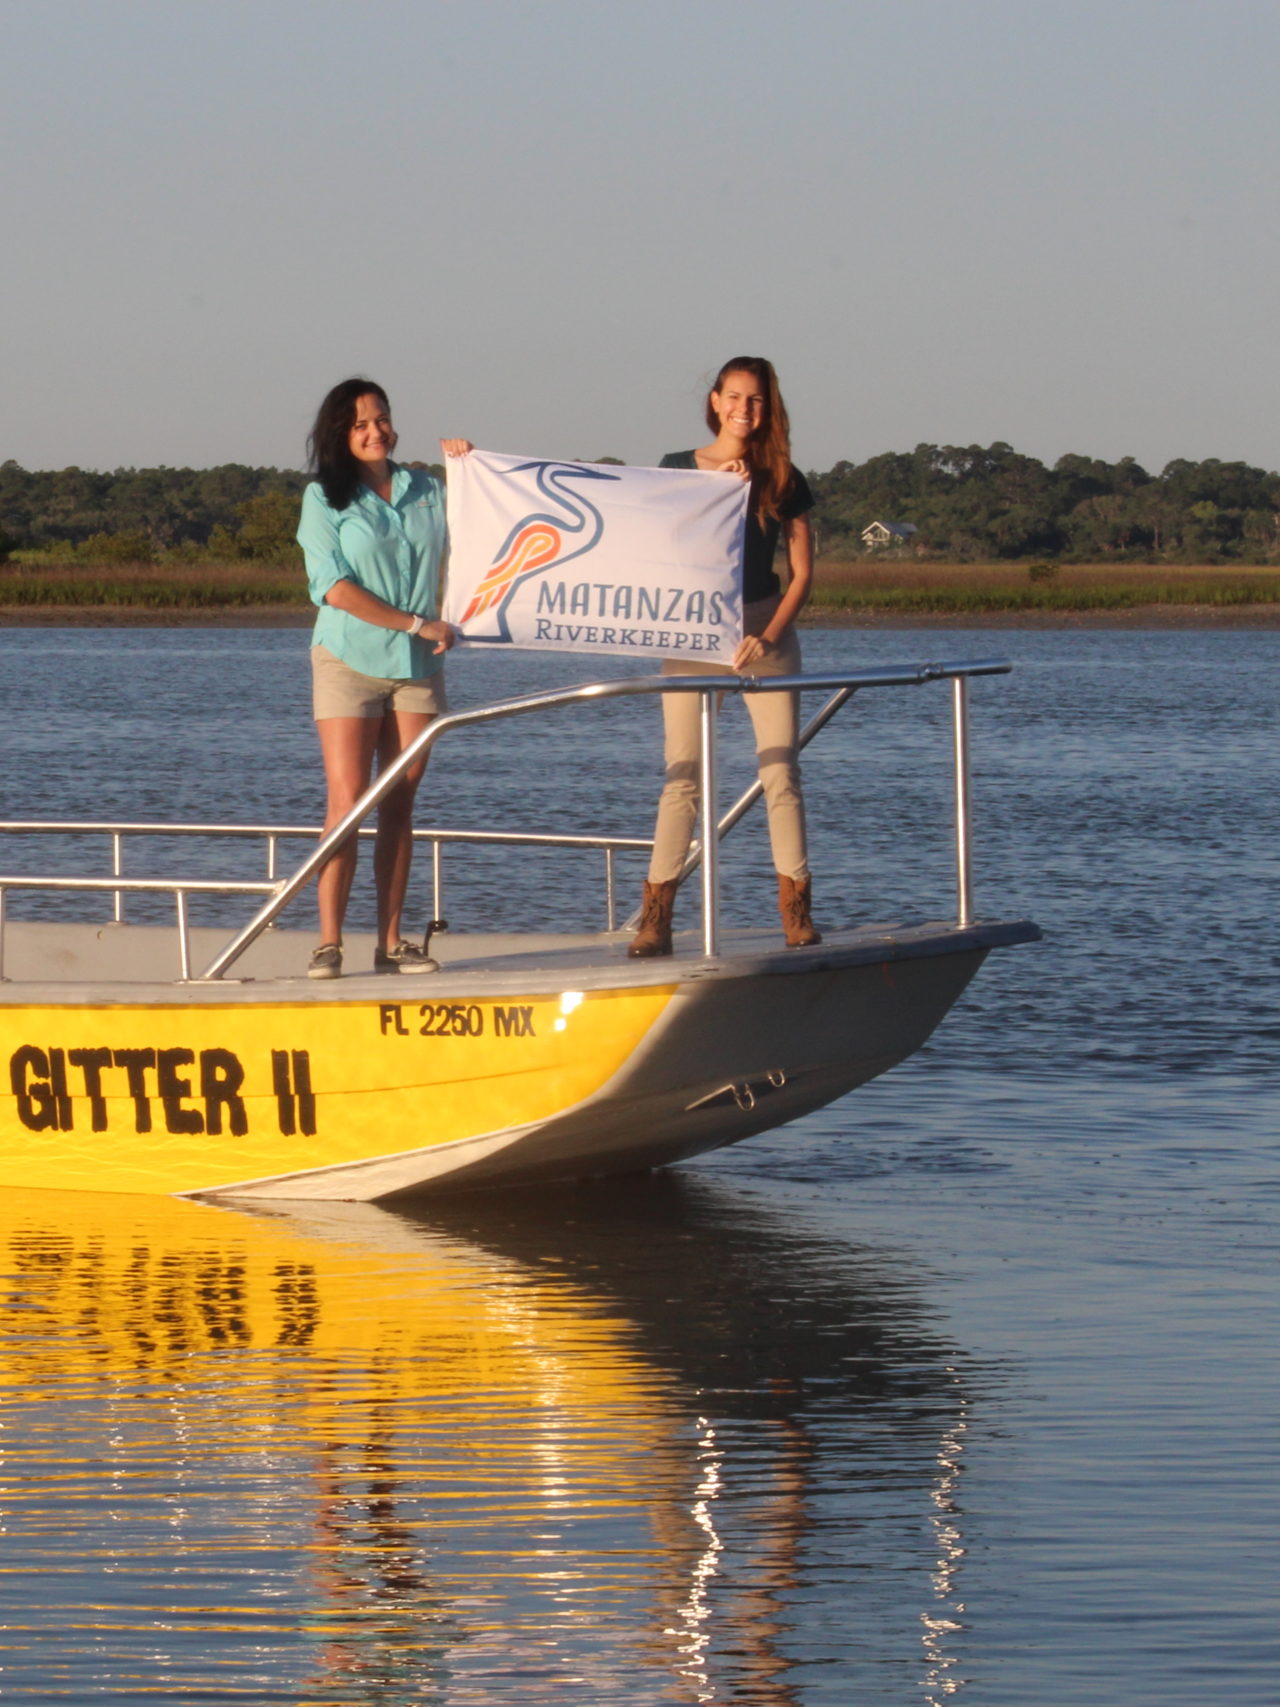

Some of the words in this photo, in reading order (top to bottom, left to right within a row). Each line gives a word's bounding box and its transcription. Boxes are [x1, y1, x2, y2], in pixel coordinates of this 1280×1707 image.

[536, 580, 723, 626] MATANZAS
[534, 618, 721, 652] RIVERKEEPER
[378, 1004, 410, 1036] FL
[419, 1004, 484, 1037] 2250
[493, 1006, 537, 1037] MX
[10, 1044, 248, 1137] GITTER
[271, 1047, 318, 1137] II
